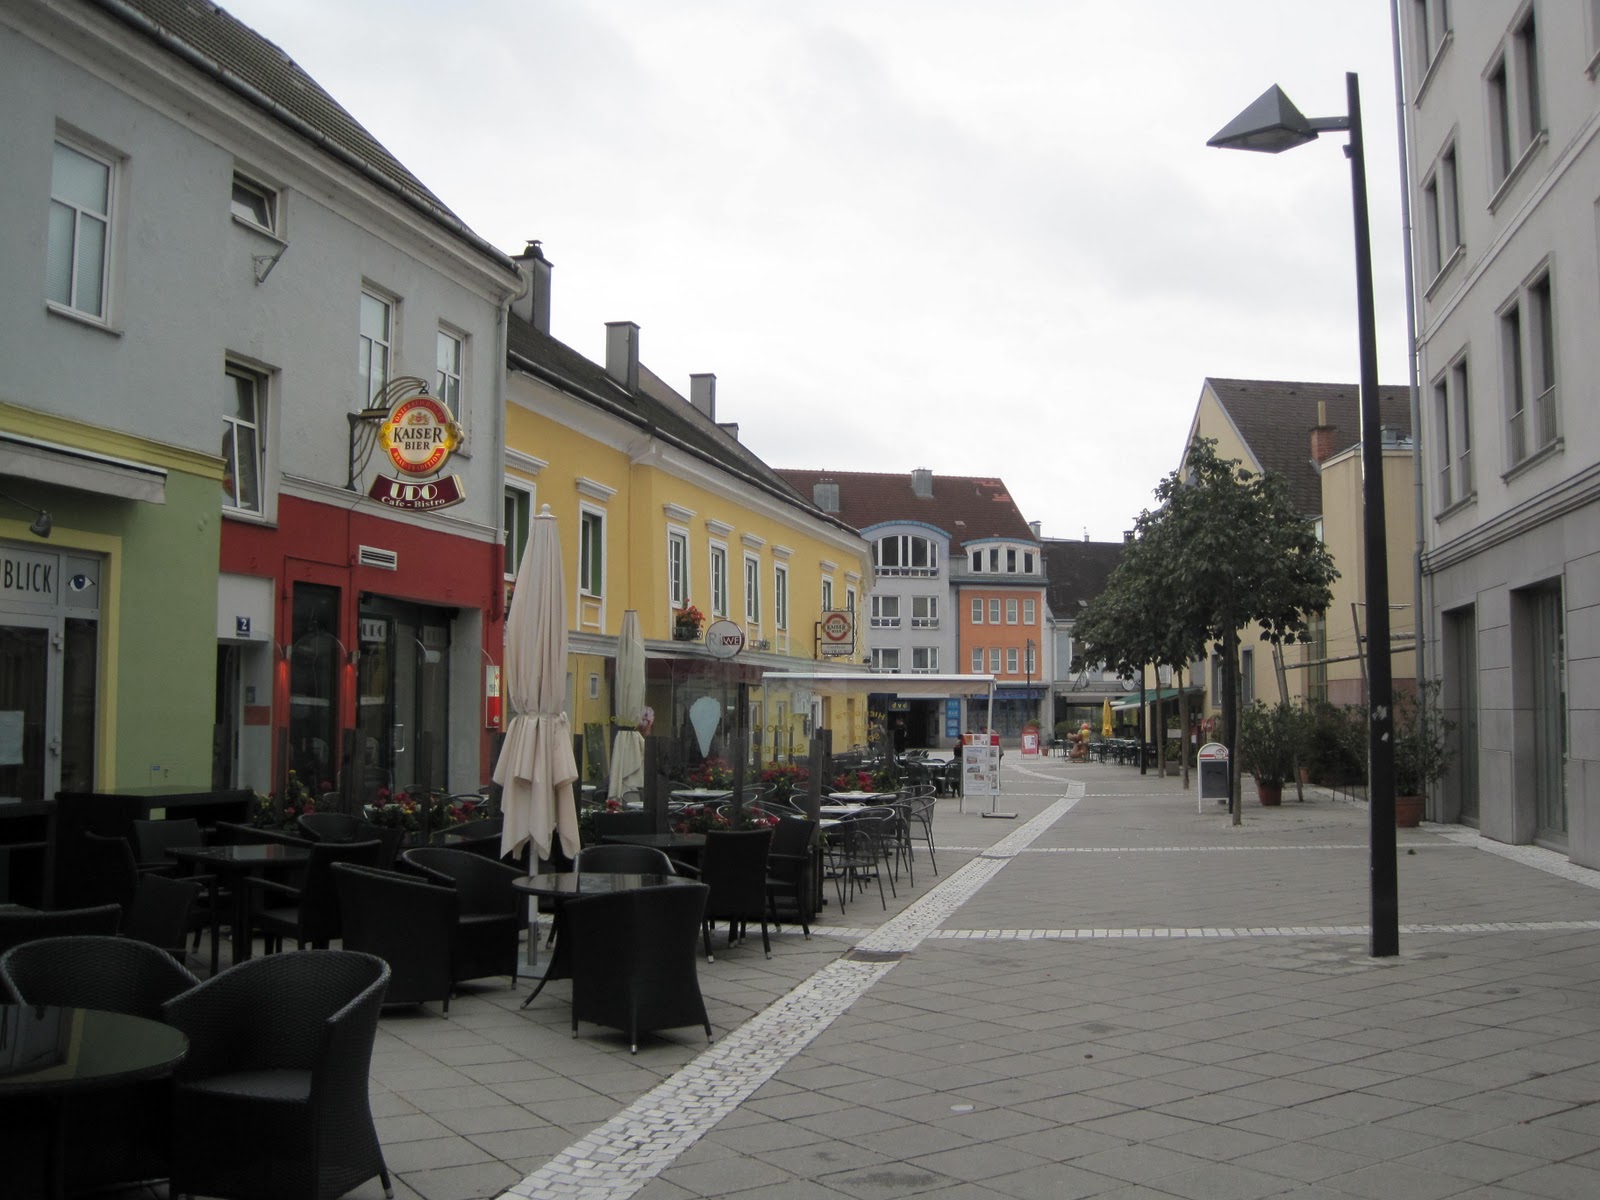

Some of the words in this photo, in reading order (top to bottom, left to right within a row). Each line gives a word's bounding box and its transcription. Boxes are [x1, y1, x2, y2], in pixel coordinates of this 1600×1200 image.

[393, 427, 443, 443] KAISER
[404, 441, 430, 450] BIER
[389, 483, 438, 501] UDO
[0, 558, 52, 594] BLICK
[241, 618, 247, 630] 2
[826, 623, 847, 631] KAISER
